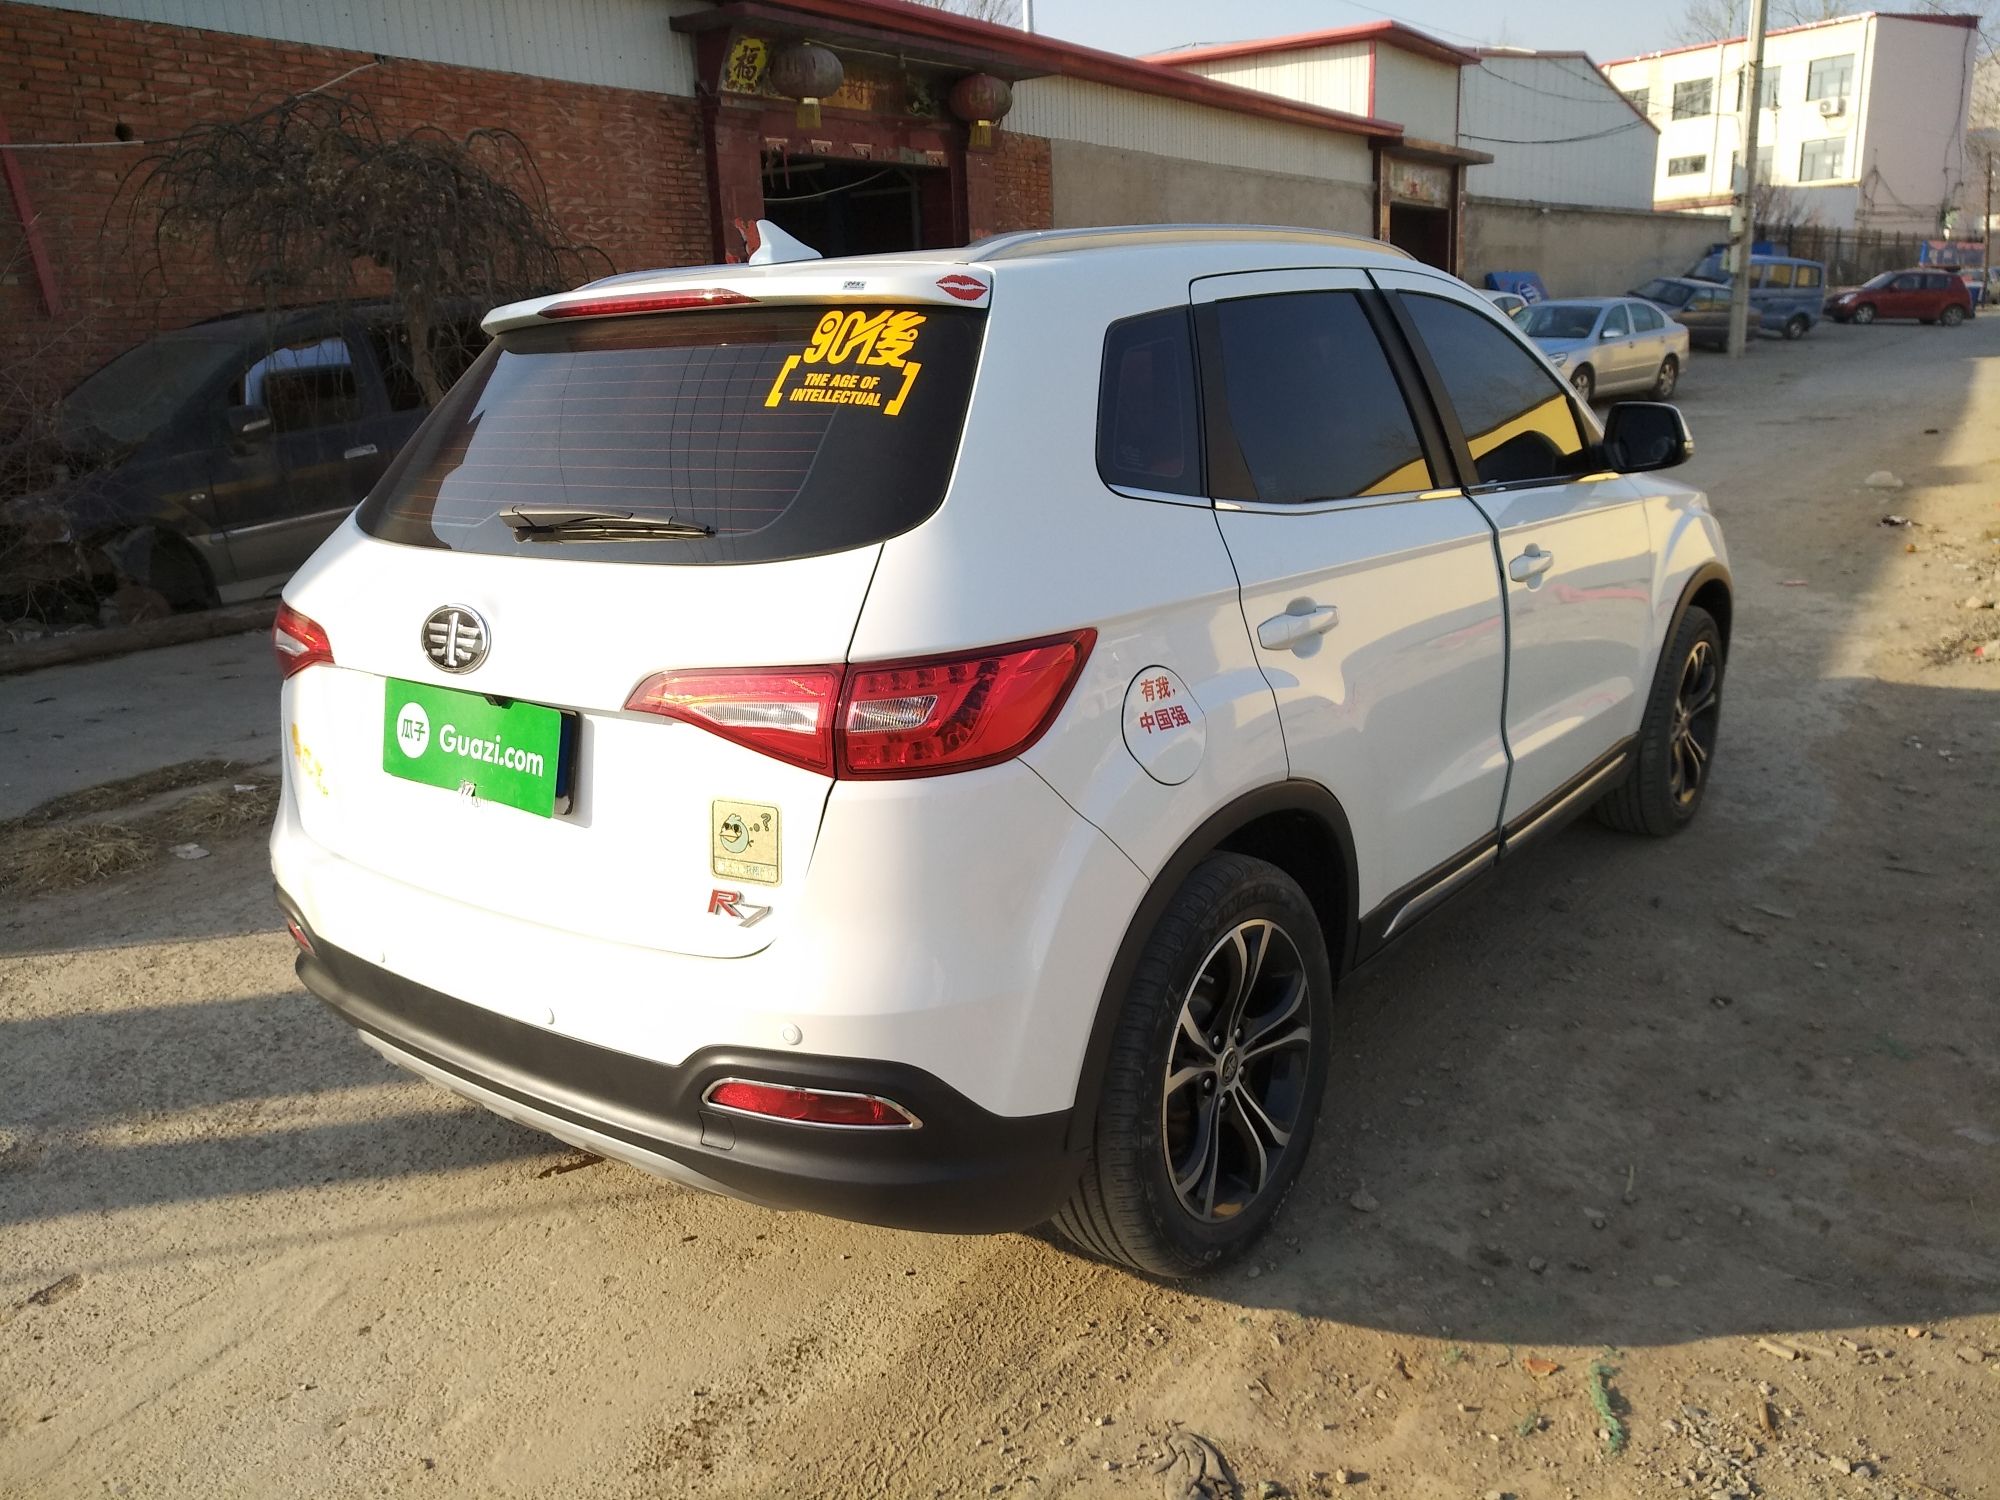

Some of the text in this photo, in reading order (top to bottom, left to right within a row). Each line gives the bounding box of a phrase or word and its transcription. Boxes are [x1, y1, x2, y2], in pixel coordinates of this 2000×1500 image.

[734, 45, 760, 80] 福
[804, 373, 880, 389] THE AGE OF
[789, 388, 881, 407] INTELLECTUAL
[401, 718, 426, 742] 瓜子
[1140, 705, 1191, 734] 中国强
[439, 724, 544, 777] Guazi.com
[708, 889, 773, 928] R7
